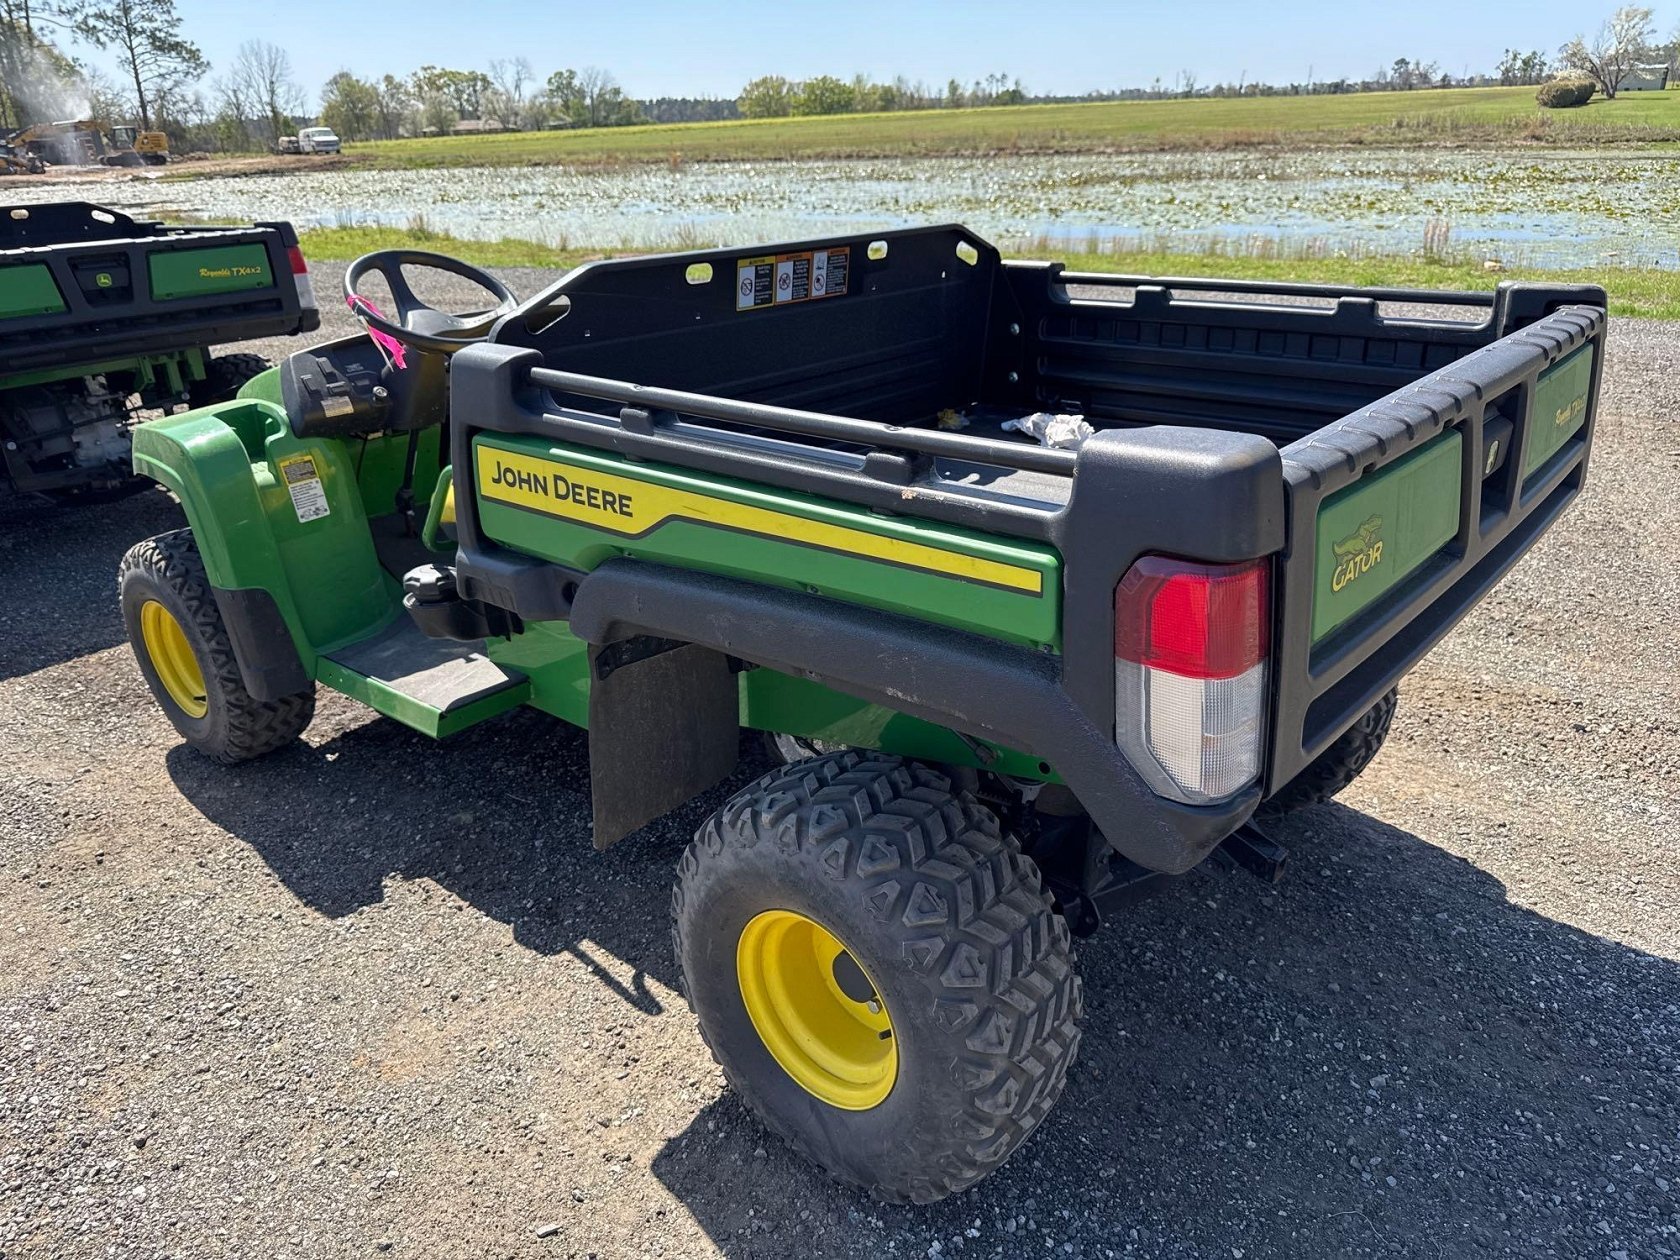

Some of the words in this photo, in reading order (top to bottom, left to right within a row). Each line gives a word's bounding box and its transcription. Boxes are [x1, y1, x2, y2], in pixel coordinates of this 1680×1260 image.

[491, 460, 549, 497] JOHN
[552, 474, 634, 518] DEERE
[1331, 540, 1384, 593] GATOR
